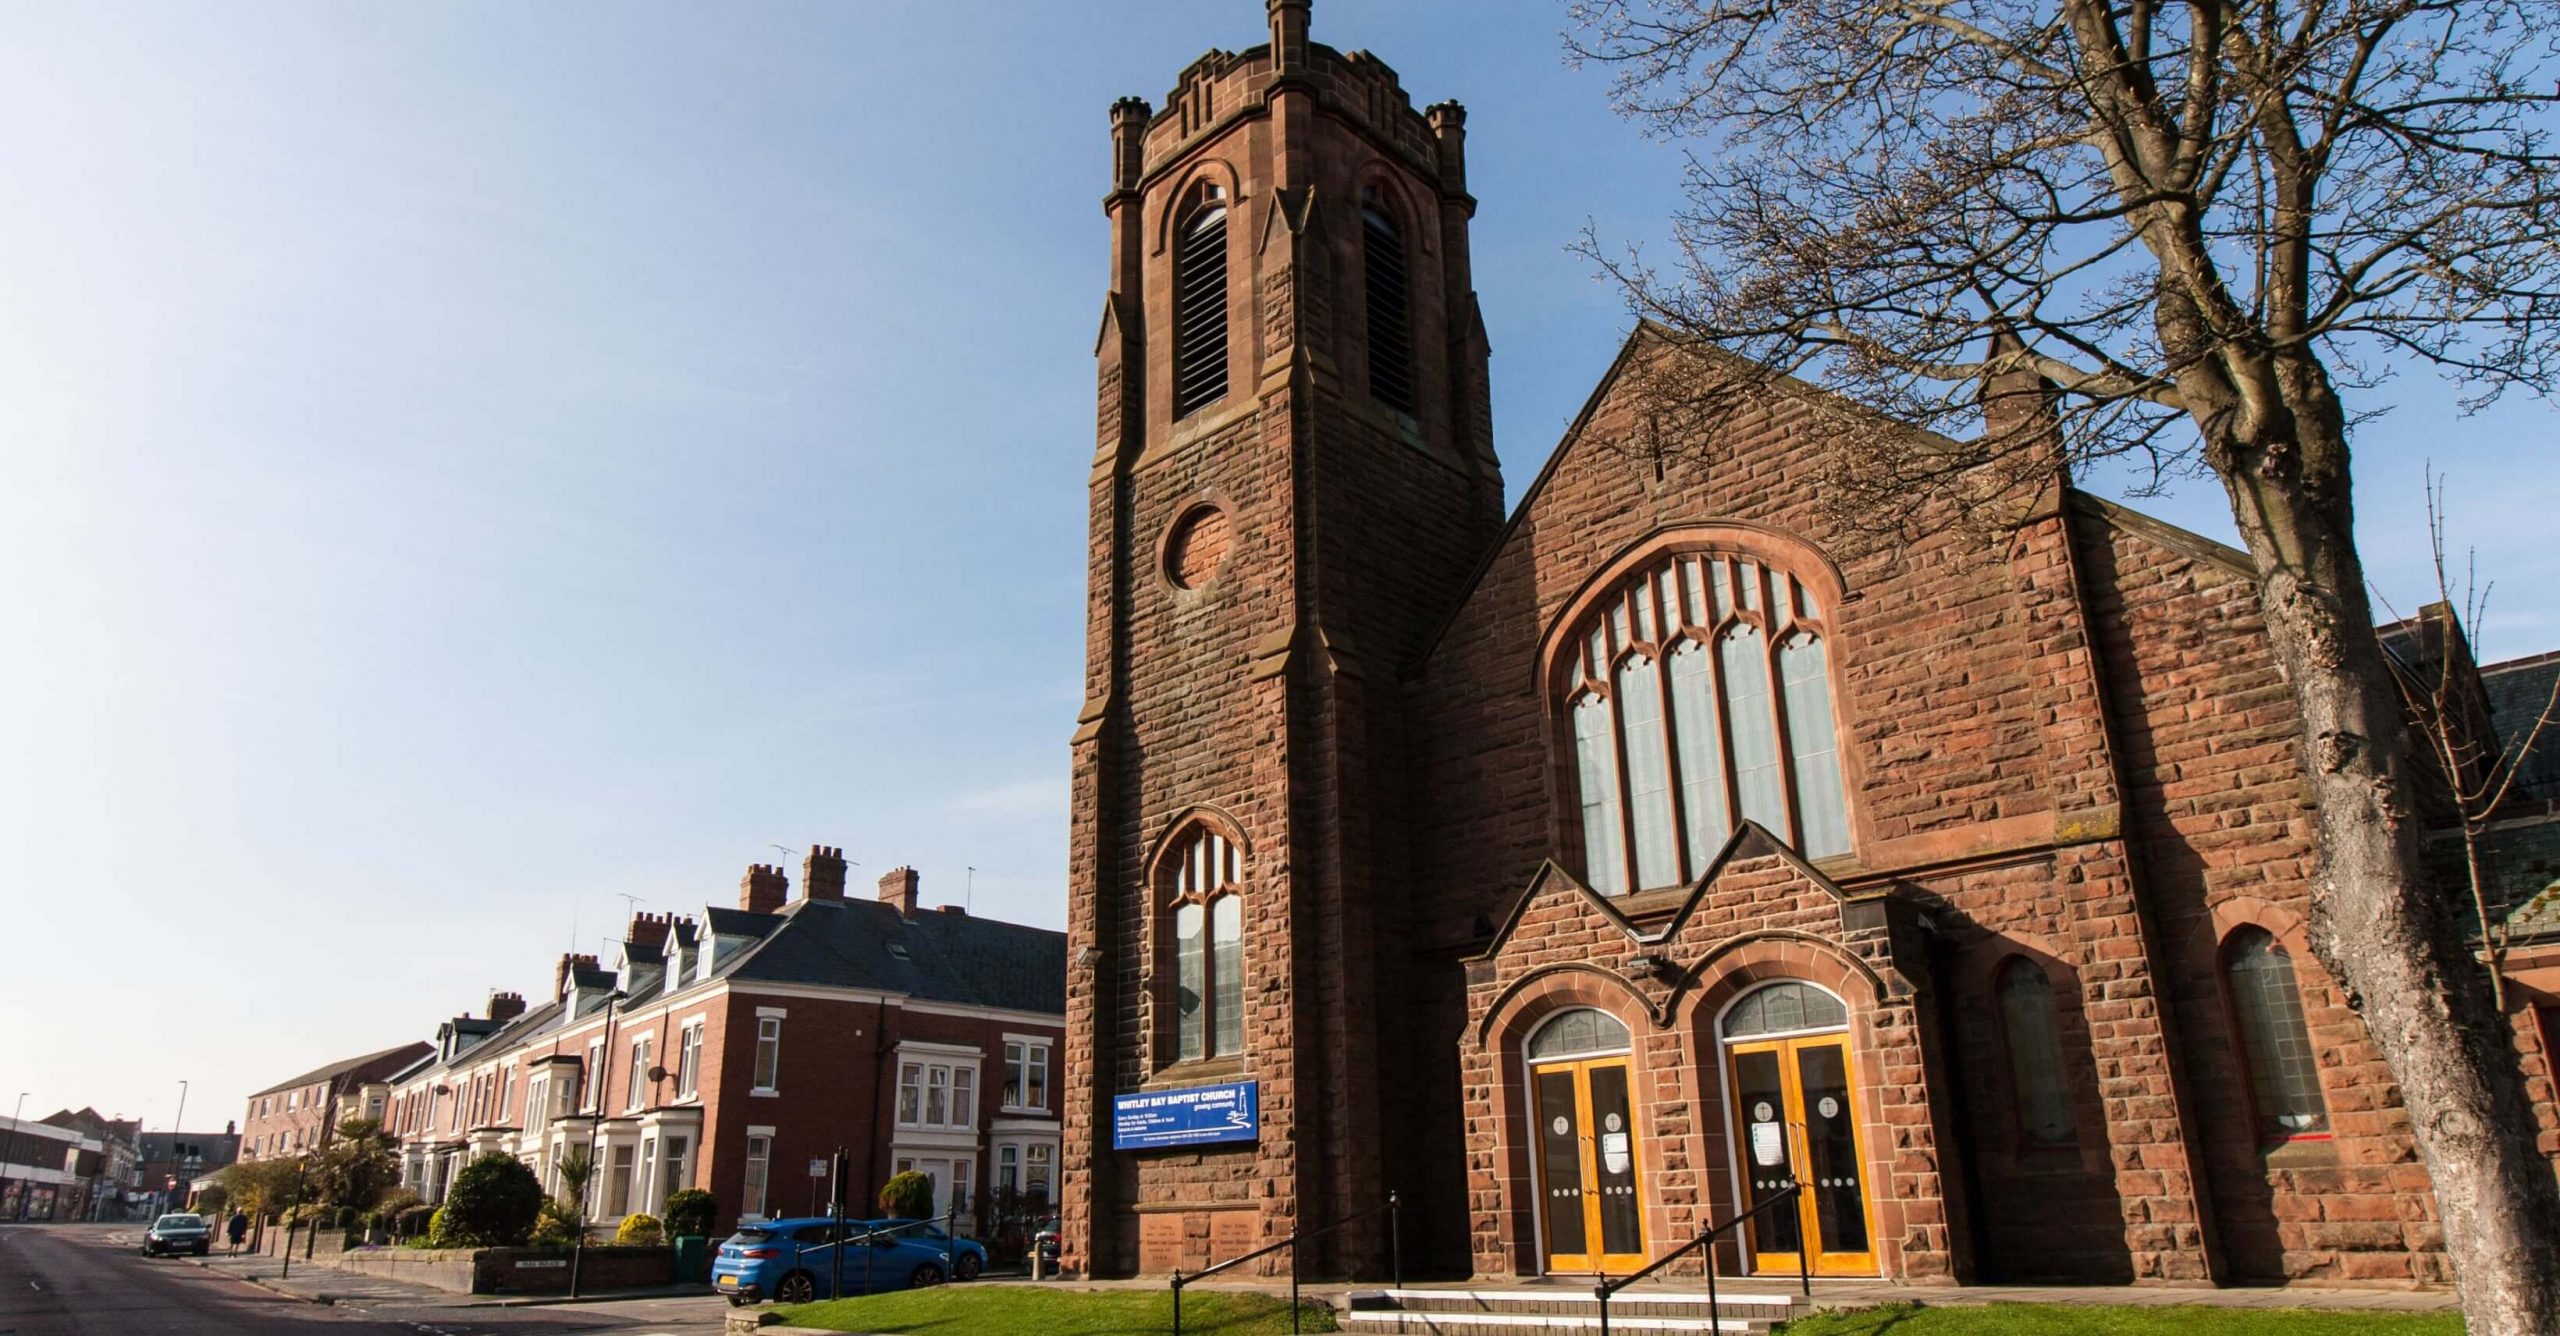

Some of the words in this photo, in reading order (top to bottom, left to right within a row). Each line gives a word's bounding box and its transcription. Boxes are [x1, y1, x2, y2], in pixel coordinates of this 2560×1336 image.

[1118, 1098, 1149, 1110] WHITLEY
[1151, 1097, 1166, 1107] BAY
[1167, 1093, 1199, 1105] BAPTIST
[1201, 1090, 1235, 1101] CHURCH
